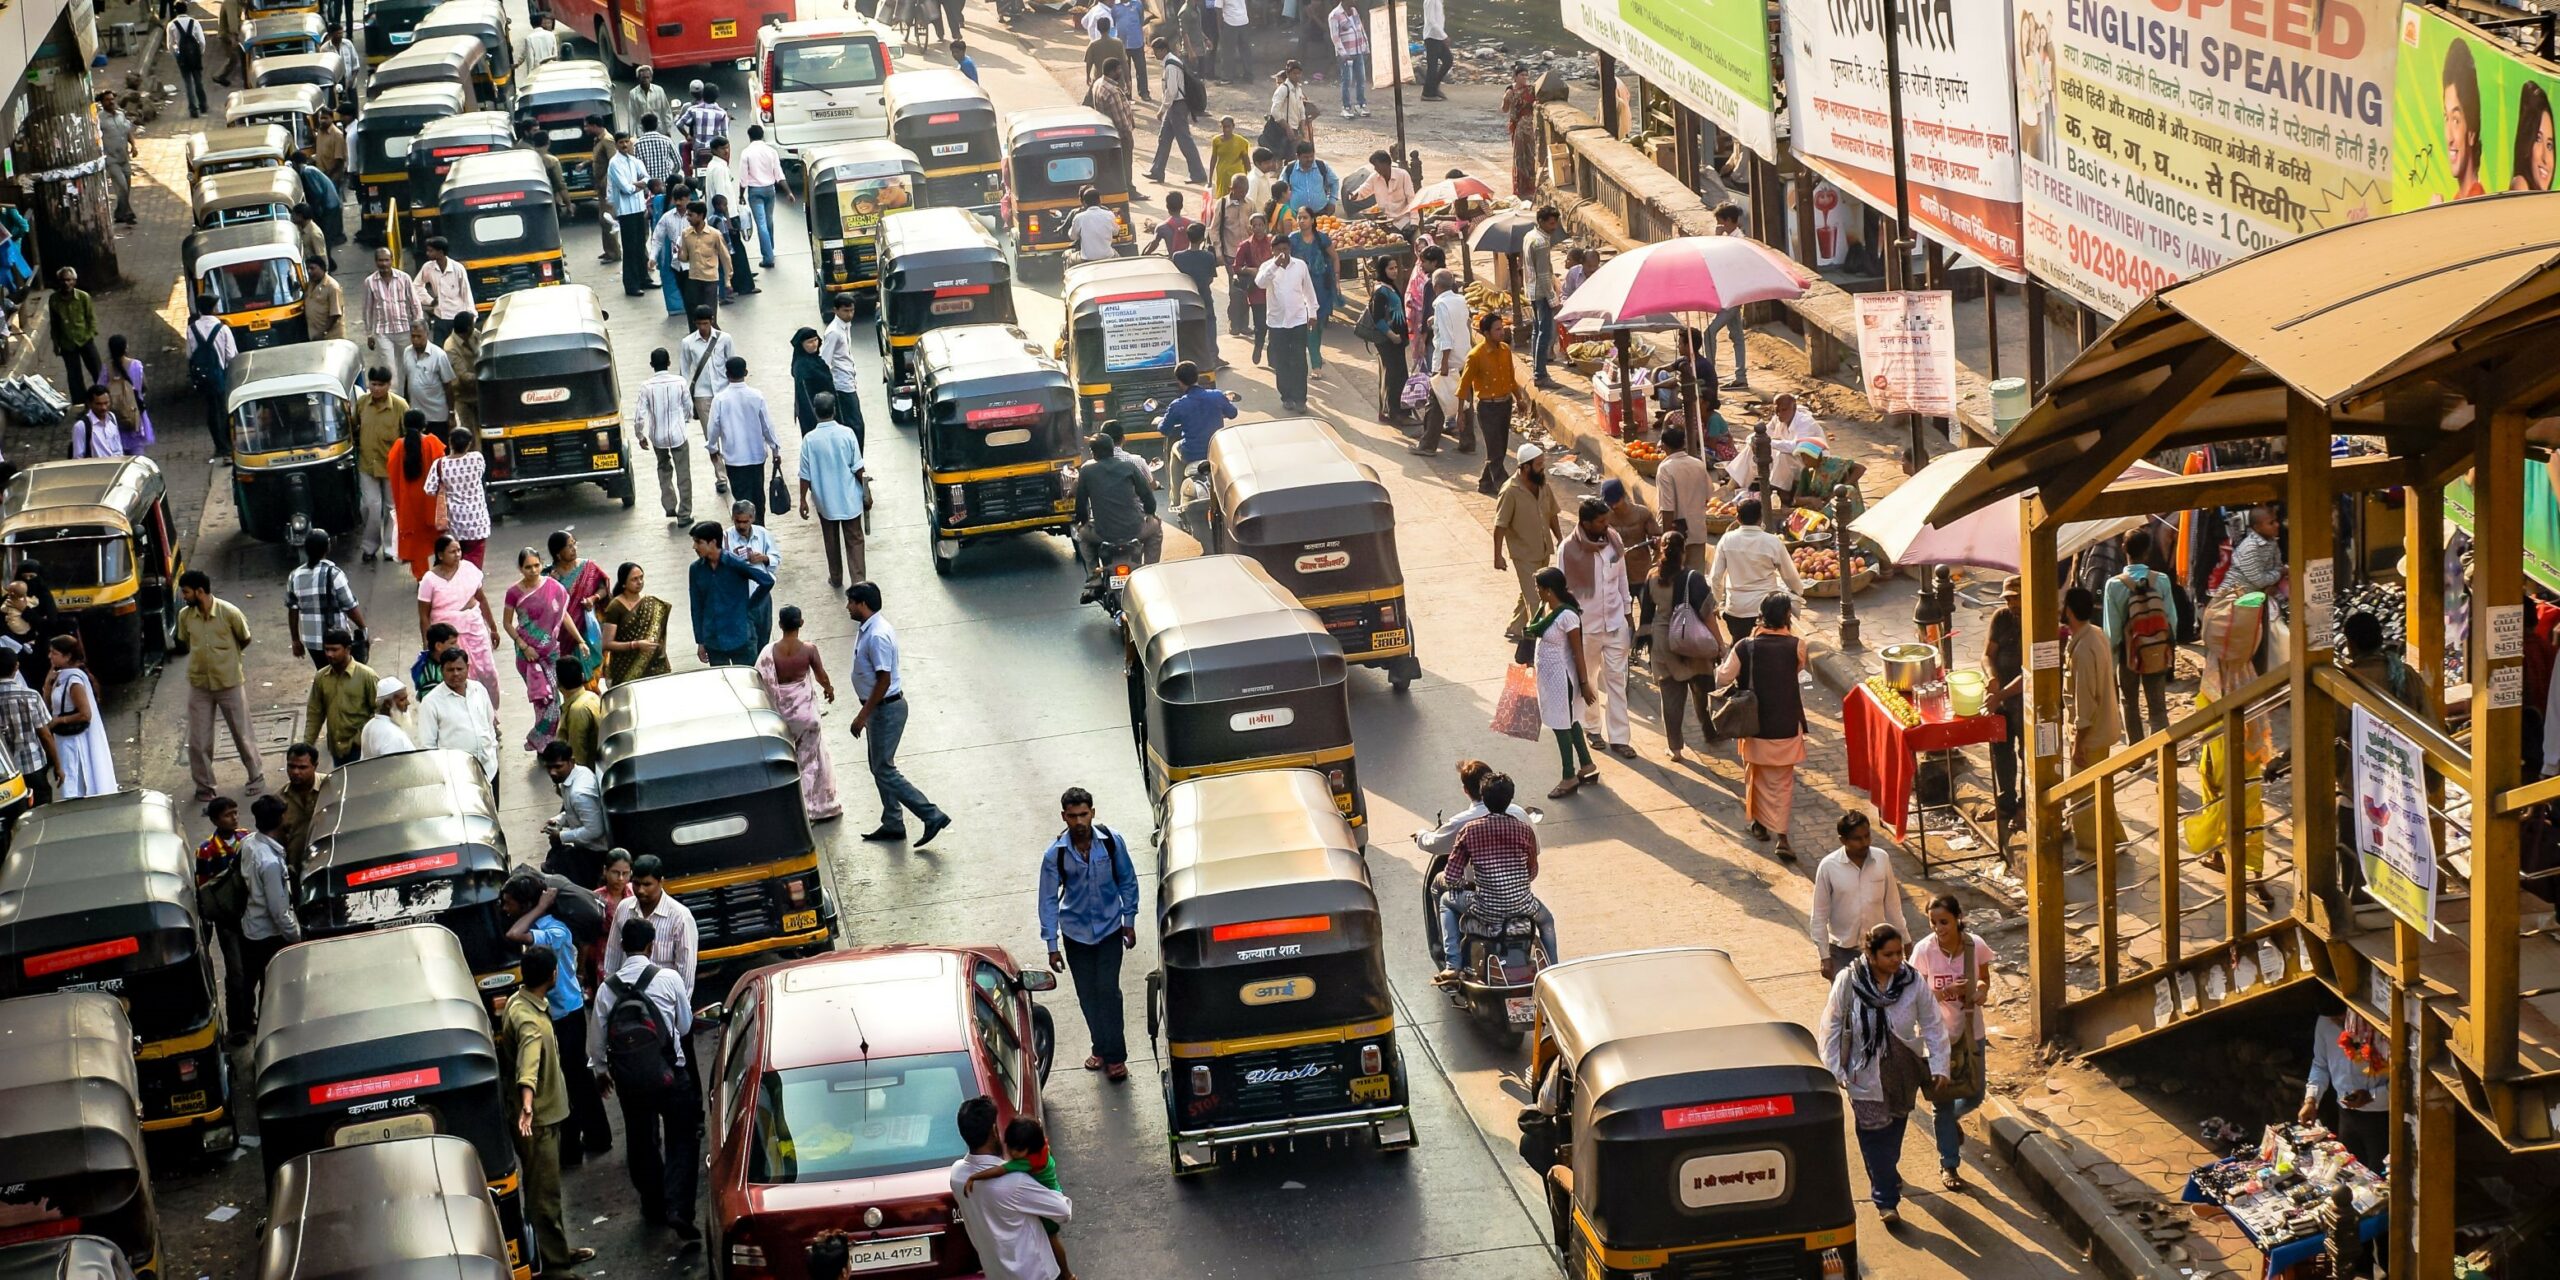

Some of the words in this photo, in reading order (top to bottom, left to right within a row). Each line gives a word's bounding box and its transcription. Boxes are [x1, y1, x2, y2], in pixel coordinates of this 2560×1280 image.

[1581, 4, 1593, 29] Toll
[1594, 15, 1608, 37] free
[1678, 72, 1687, 87] or
[2067, 0, 2189, 69] ENGLISH
[2201, 36, 2383, 127] SPEAKING
[1911, 64, 1932, 97] रोजी
[1935, 72, 1969, 109] शुभारंभ
[2064, 43, 2080, 66] क्या
[2081, 50, 2112, 80] आपको
[2116, 57, 2145, 90] अंग्रेजी
[2217, 98, 2231, 120] या
[2234, 97, 2265, 132] बोलने
[2269, 107, 2279, 133] में
[2283, 114, 2330, 153] परेशानी
[2334, 129, 2363, 162] होती
[2086, 84, 2105, 112] हिंदी
[2108, 95, 2125, 119] और
[2127, 106, 2155, 131] मराठी
[2158, 111, 2167, 135] में
[2170, 117, 2189, 143] और
[2191, 130, 2223, 155] उच्चार
[2227, 137, 2261, 168] अंग्रेजी
[2264, 149, 2275, 173] में
[2278, 157, 2312, 186] करिये
[2023, 163, 2040, 193] GET
[2044, 175, 2072, 208] FREE
[2076, 190, 2145, 243] INTERVIEW
[2149, 224, 2182, 259] TIPS
[2067, 146, 2107, 188] Basic
[2125, 173, 2198, 227] Advance
[2220, 212, 2231, 241] 1
[2205, 162, 2223, 198] से
[2230, 171, 2307, 234] सिखीए
[1237, 947, 1277, 961] कल्याण
[1279, 944, 1302, 956] शहर
[1254, 981, 1297, 997] आई
[348, 1100, 389, 1115] कल्याण
[391, 1095, 417, 1107] शहर
[1245, 1062, 1327, 1084] Yash
